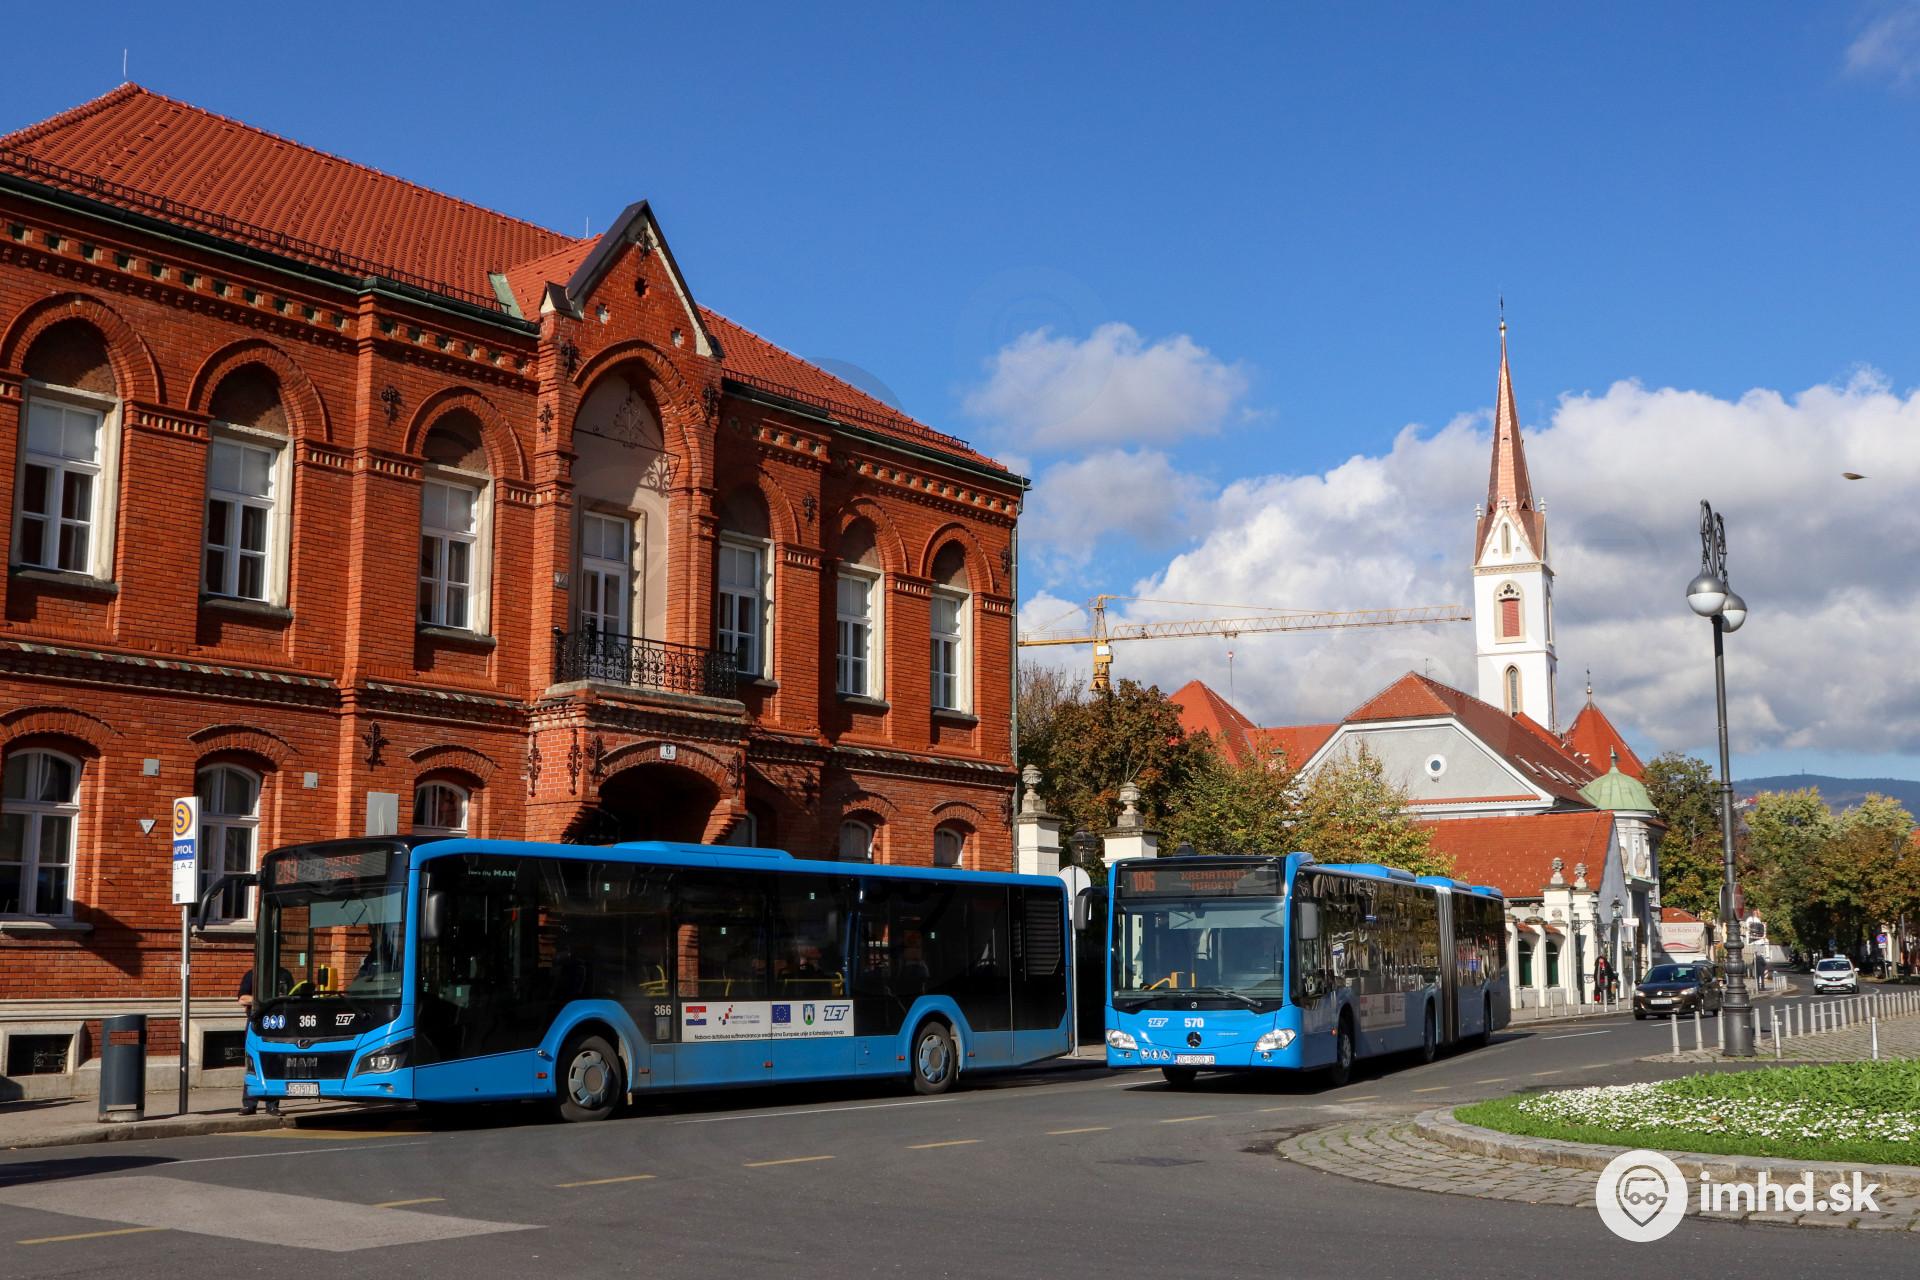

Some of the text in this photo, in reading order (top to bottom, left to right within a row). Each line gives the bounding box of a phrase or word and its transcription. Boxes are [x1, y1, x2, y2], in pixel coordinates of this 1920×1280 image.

[173, 844, 193, 855] APTOL
[654, 1004, 672, 1016] 366
[823, 1005, 850, 1021] ZET
[299, 1015, 317, 1027] 366
[335, 1013, 355, 1026] ZET
[1147, 1018, 1168, 1028] ZET
[1184, 1017, 1204, 1028] 570
